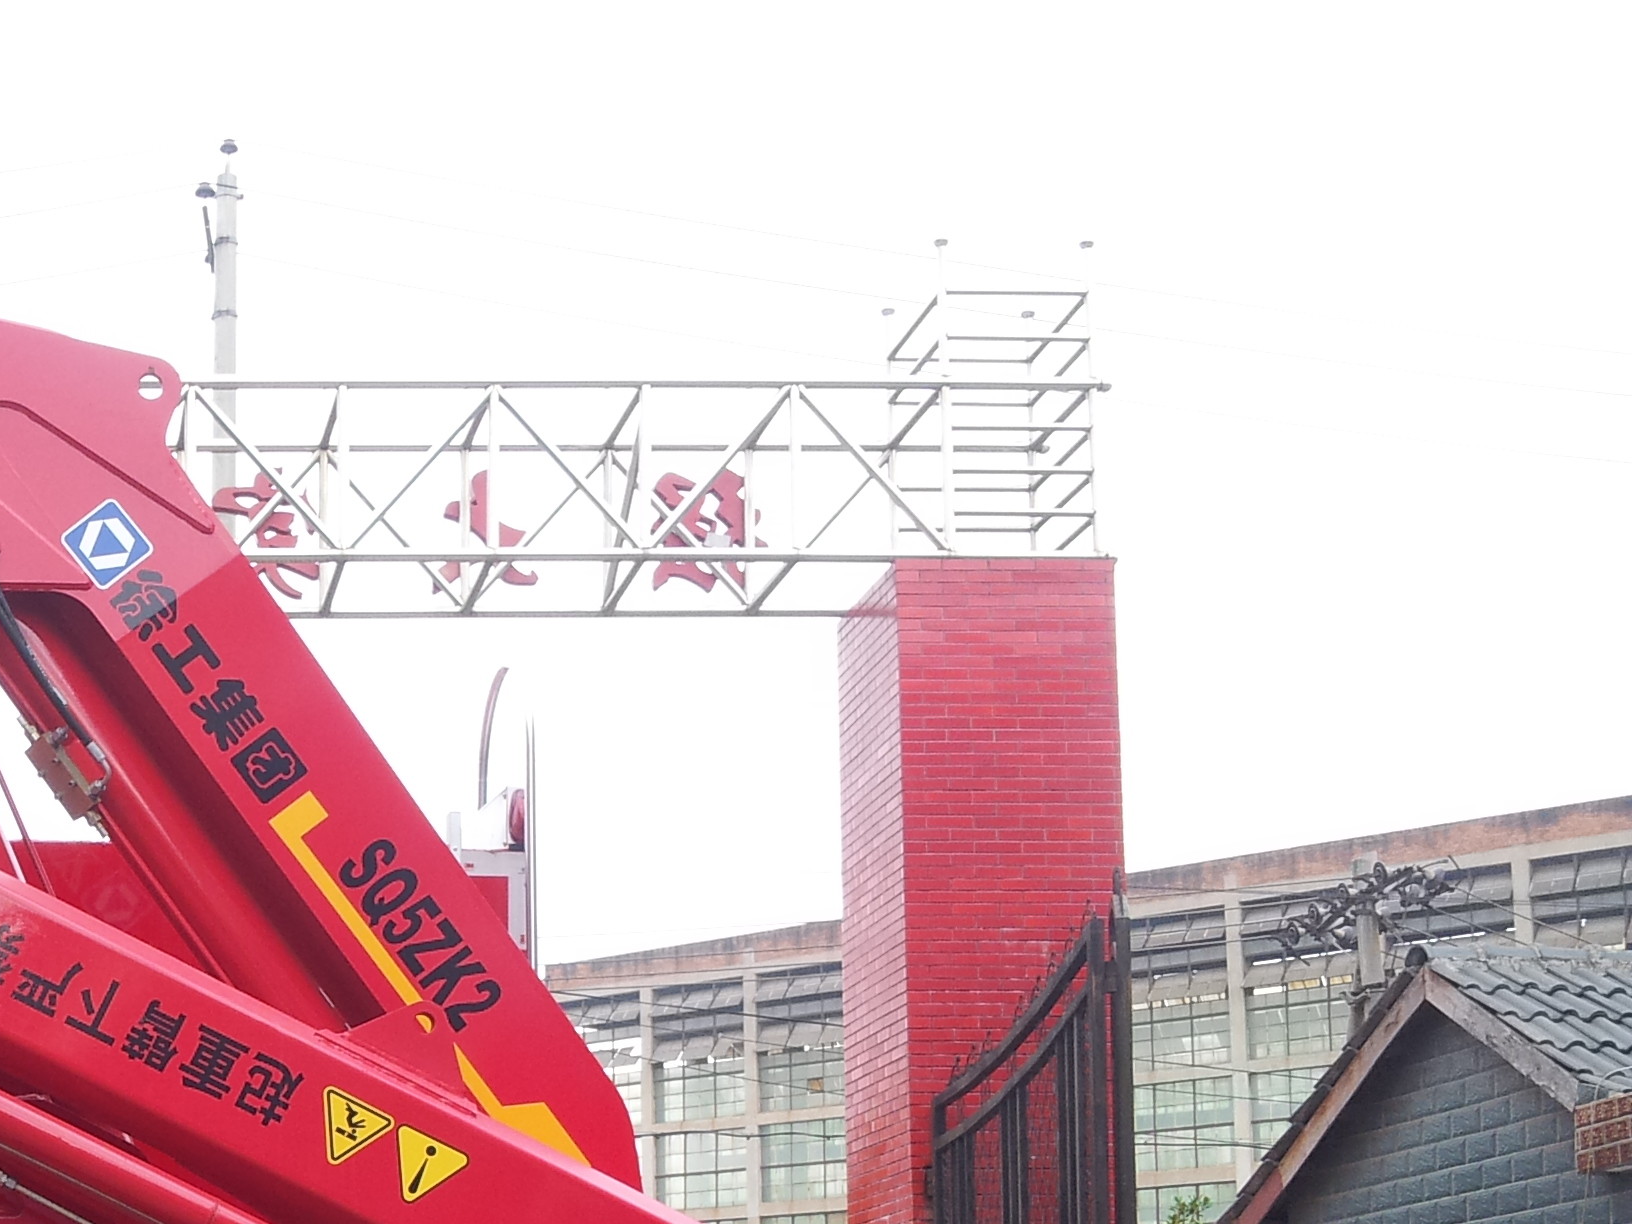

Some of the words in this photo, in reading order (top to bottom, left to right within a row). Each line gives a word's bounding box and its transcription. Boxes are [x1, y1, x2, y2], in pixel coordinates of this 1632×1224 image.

[109, 569, 309, 804] 徐工集团
[339, 838, 501, 1033] SQ5ZK2
